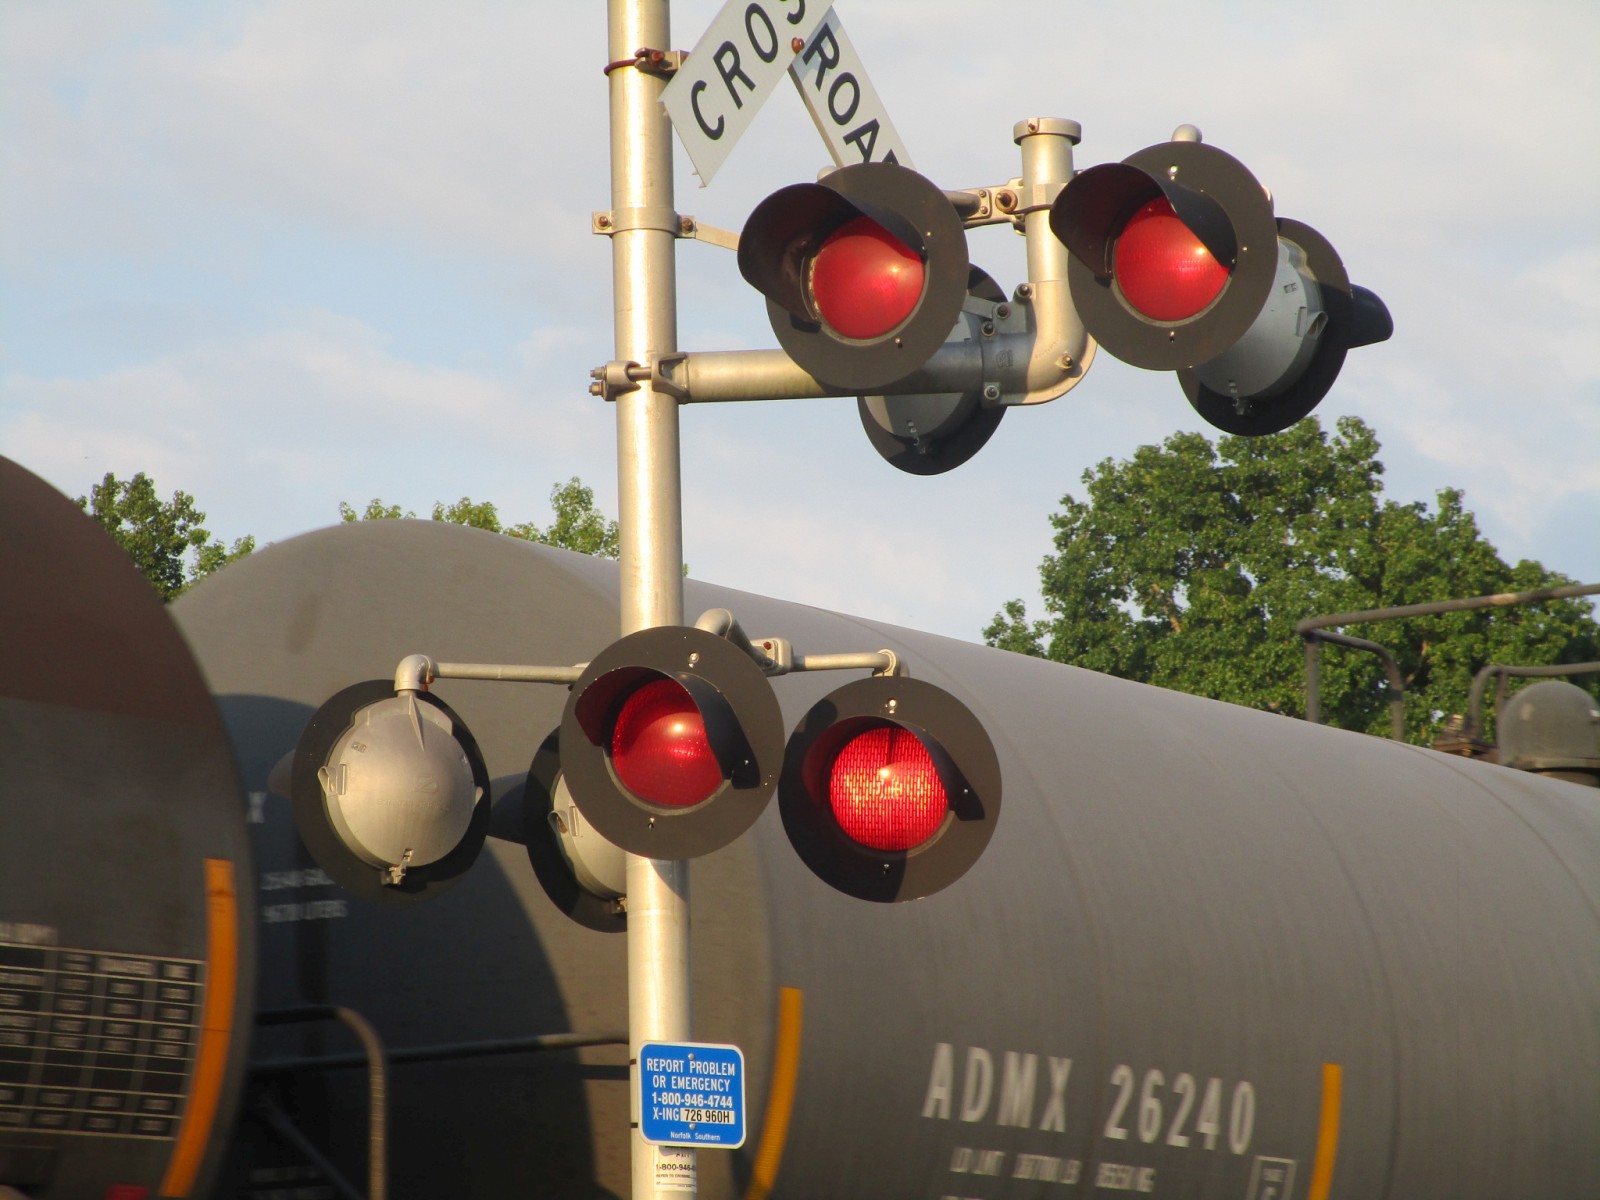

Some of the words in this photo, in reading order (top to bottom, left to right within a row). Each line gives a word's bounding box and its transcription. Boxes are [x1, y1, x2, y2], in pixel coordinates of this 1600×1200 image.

[802, 22, 900, 165] ROA
[646, 1058, 685, 1073] REPORT
[689, 1060, 736, 1076] PROBLEM
[652, 1074, 666, 1088] OR
[671, 1076, 730, 1092] EMERGENCY
[652, 1091, 733, 1108] 1-800-946-4744
[922, 1043, 1072, 1132] ADMX
[1105, 1064, 1255, 1155] 26240
[652, 1107, 680, 1120] X-ING
[684, 1109, 702, 1122] 726
[705, 1110, 730, 1123] 960H
[670, 1131, 691, 1139] Norfolk
[694, 1132, 720, 1141] Southern
